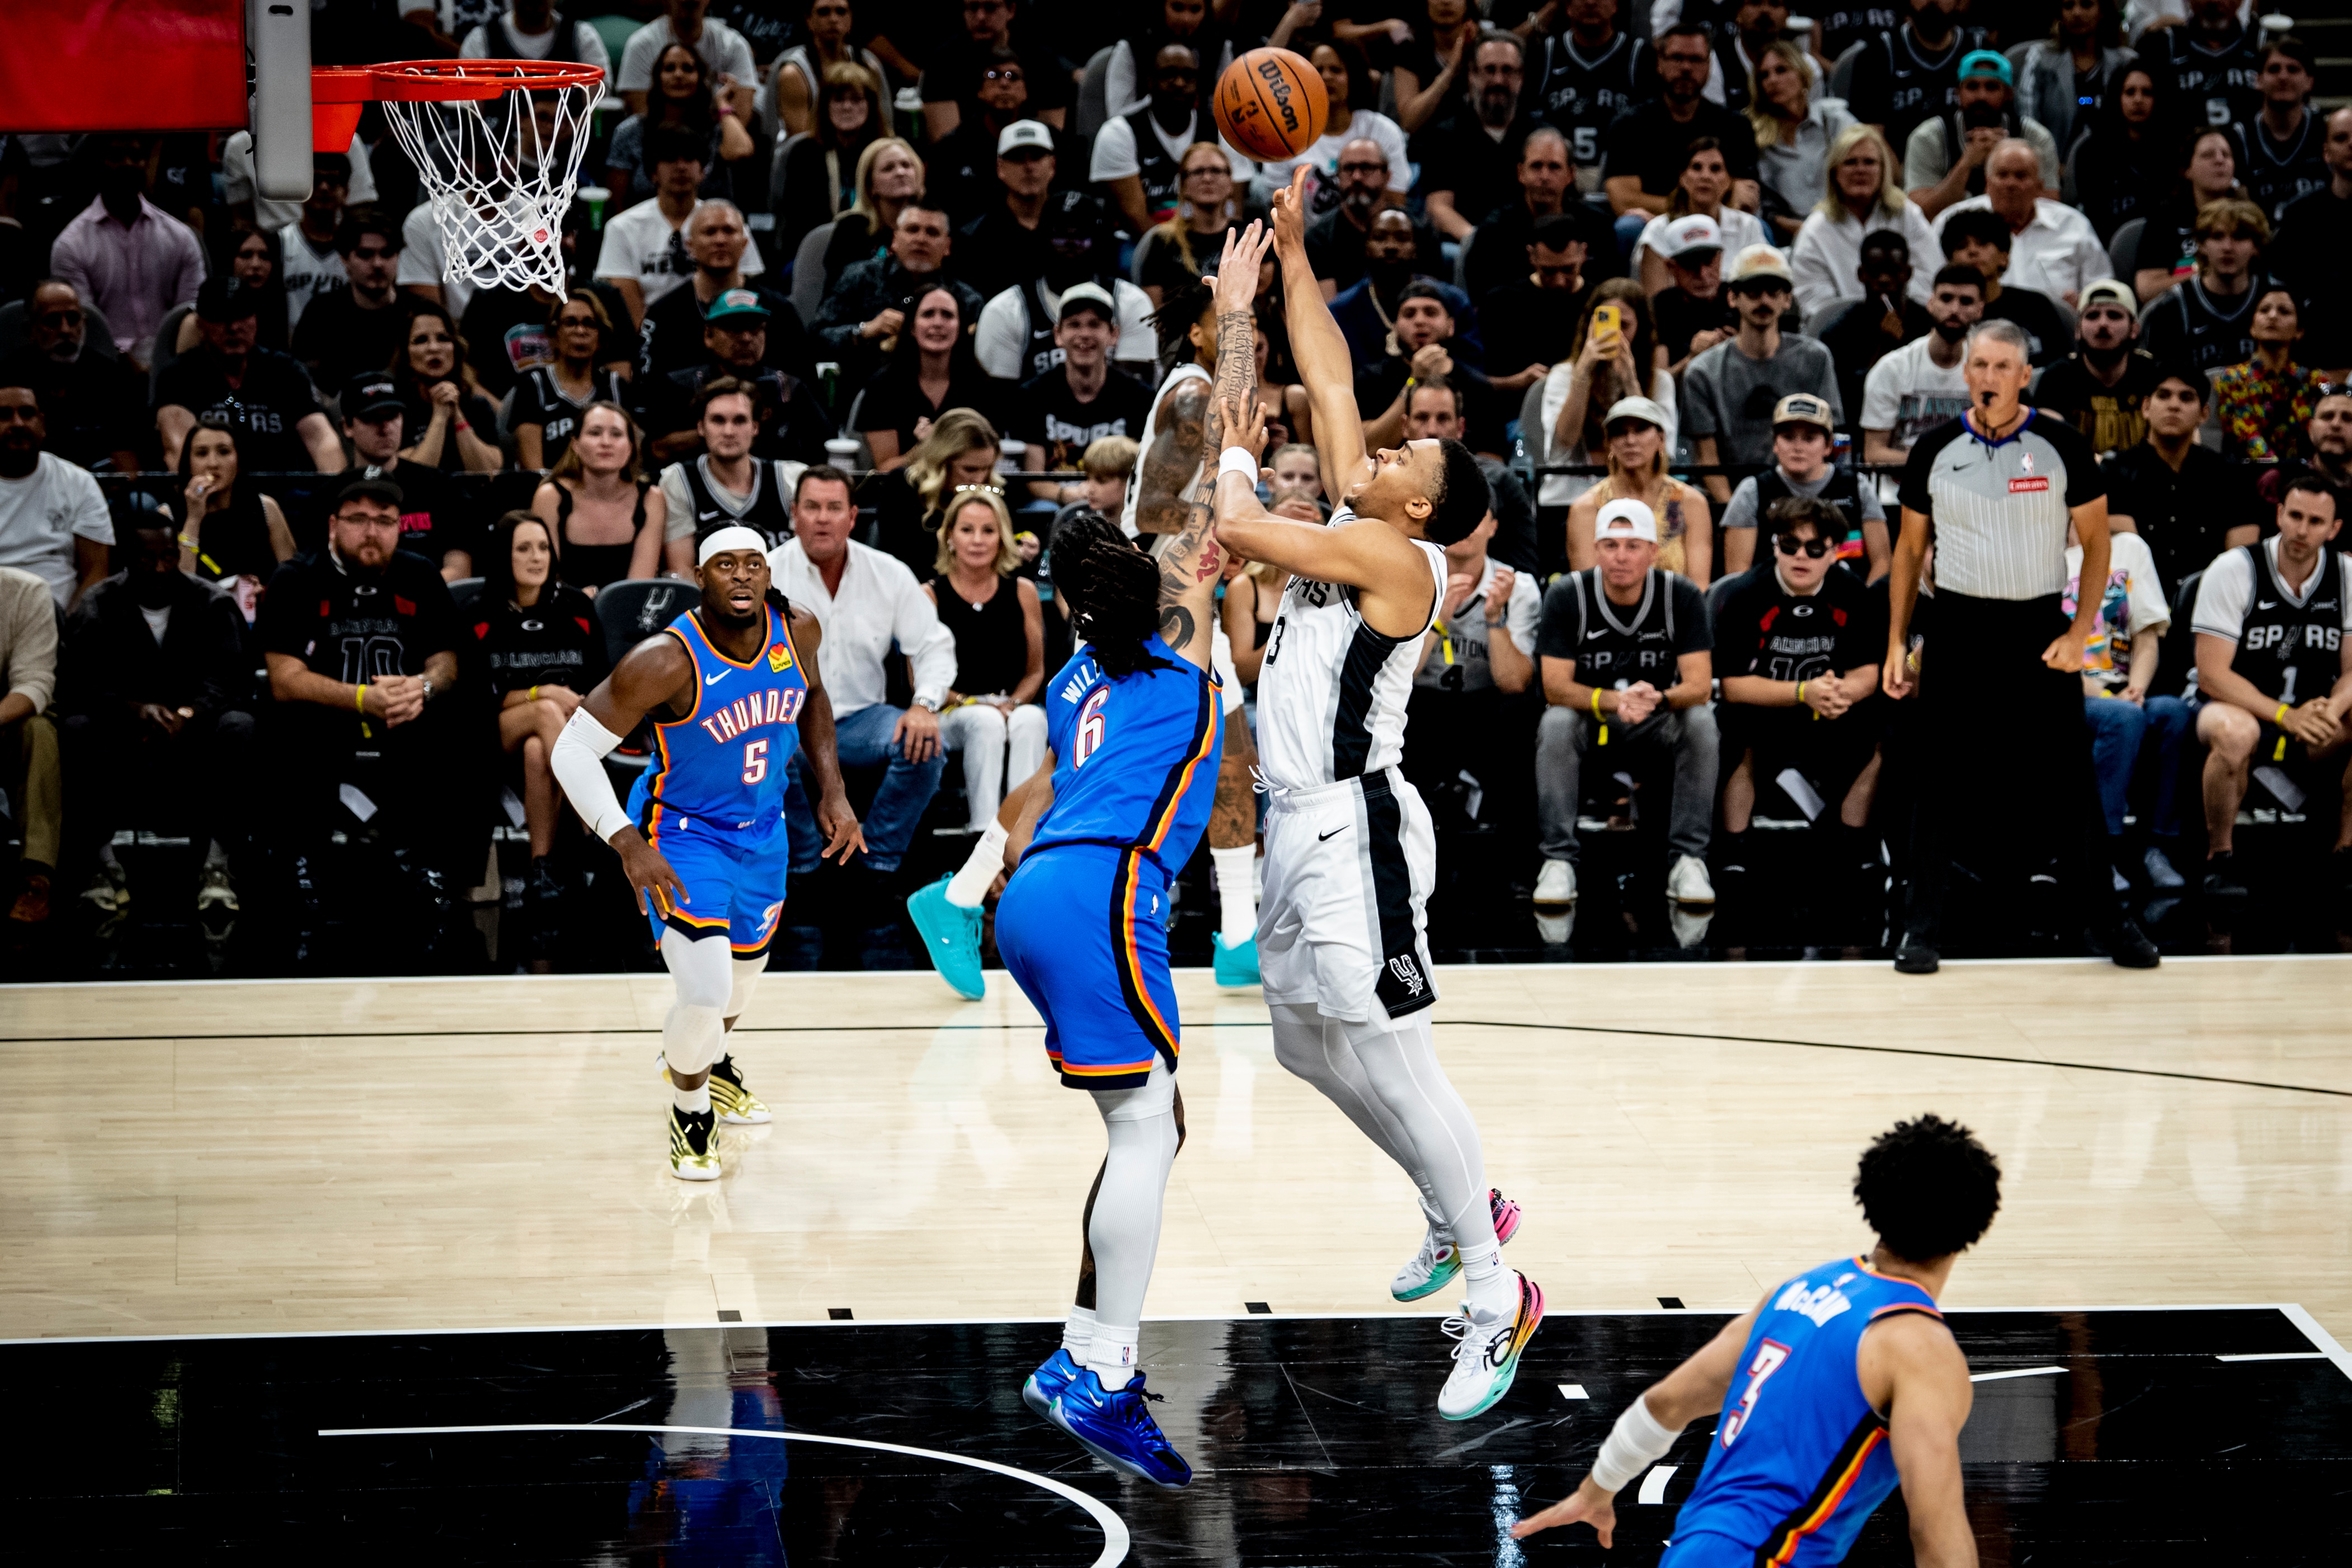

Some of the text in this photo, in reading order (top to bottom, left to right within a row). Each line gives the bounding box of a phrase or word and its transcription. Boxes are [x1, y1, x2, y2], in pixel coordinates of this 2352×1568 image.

[1258, 60, 1299, 133] Wilson
[2205, 97, 2232, 125] 5
[1573, 126, 1598, 161] 5
[341, 635, 404, 685] 10
[1440, 665, 1464, 695] 4
[2278, 665, 2298, 705] 1
[699, 689, 806, 743] THUNDER
[1074, 685, 1110, 772] 6
[741, 737, 769, 785] 5
[1720, 1337, 1793, 1450] 3
